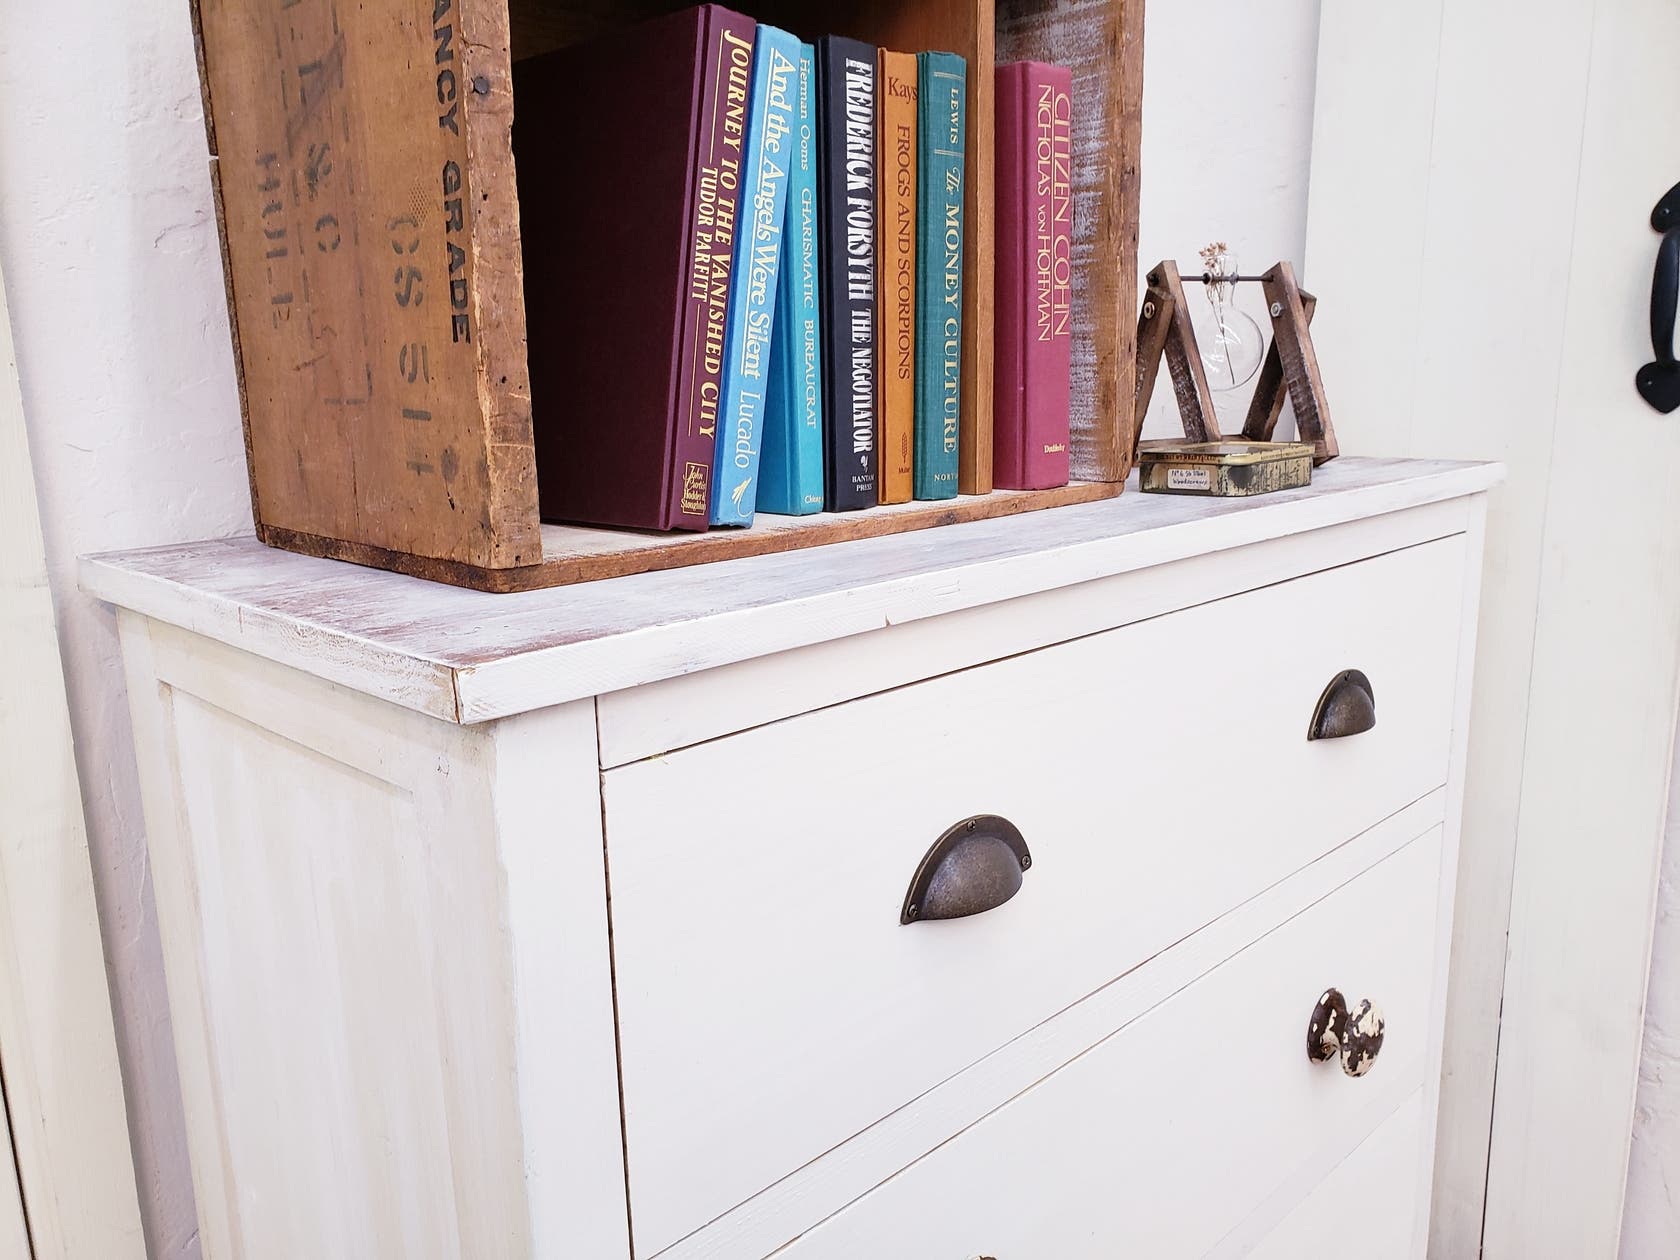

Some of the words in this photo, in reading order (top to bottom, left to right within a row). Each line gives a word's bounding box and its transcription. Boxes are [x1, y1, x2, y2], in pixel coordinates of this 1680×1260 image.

[724, 30, 752, 152] JOURNEY
[770, 49, 796, 112] And
[800, 58, 811, 119] Herman
[949, 88, 959, 144] LEWIS
[765, 113, 790, 153] the
[800, 125, 811, 171] Ooms
[846, 58, 873, 193] FREDERICK
[897, 124, 911, 197] FROGS
[1037, 84, 1051, 196] NICHOLAS
[1054, 93, 1071, 222] CITIZEN
[698, 167, 718, 226] TUDOR
[720, 158, 738, 190] TO
[754, 156, 784, 241] Angels
[946, 166, 960, 195] The
[443, 160, 470, 344] GRADE
[715, 197, 735, 245] THE
[801, 188, 814, 308] CHARISMATIC
[847, 196, 874, 301] FORSYTH
[898, 202, 911, 254] AND
[945, 203, 960, 310] MONEY
[692, 231, 712, 302] PARFITT
[751, 243, 777, 305] Were
[1037, 235, 1050, 341] HOFFMAN
[1054, 235, 1070, 335] COHN
[705, 254, 731, 374] VANISHED
[745, 310, 770, 380] Silent
[852, 308, 872, 343] THE
[898, 259, 911, 380] SCORPIONS
[700, 382, 719, 440] CITY
[804, 320, 817, 429] BUREAUCRAT
[852, 347, 872, 453] NEGOTIATOR
[944, 317, 959, 453] CULTURE
[735, 390, 761, 468] Lucado
[852, 473, 875, 483] BANTAM
[856, 483, 873, 492] PRESS
